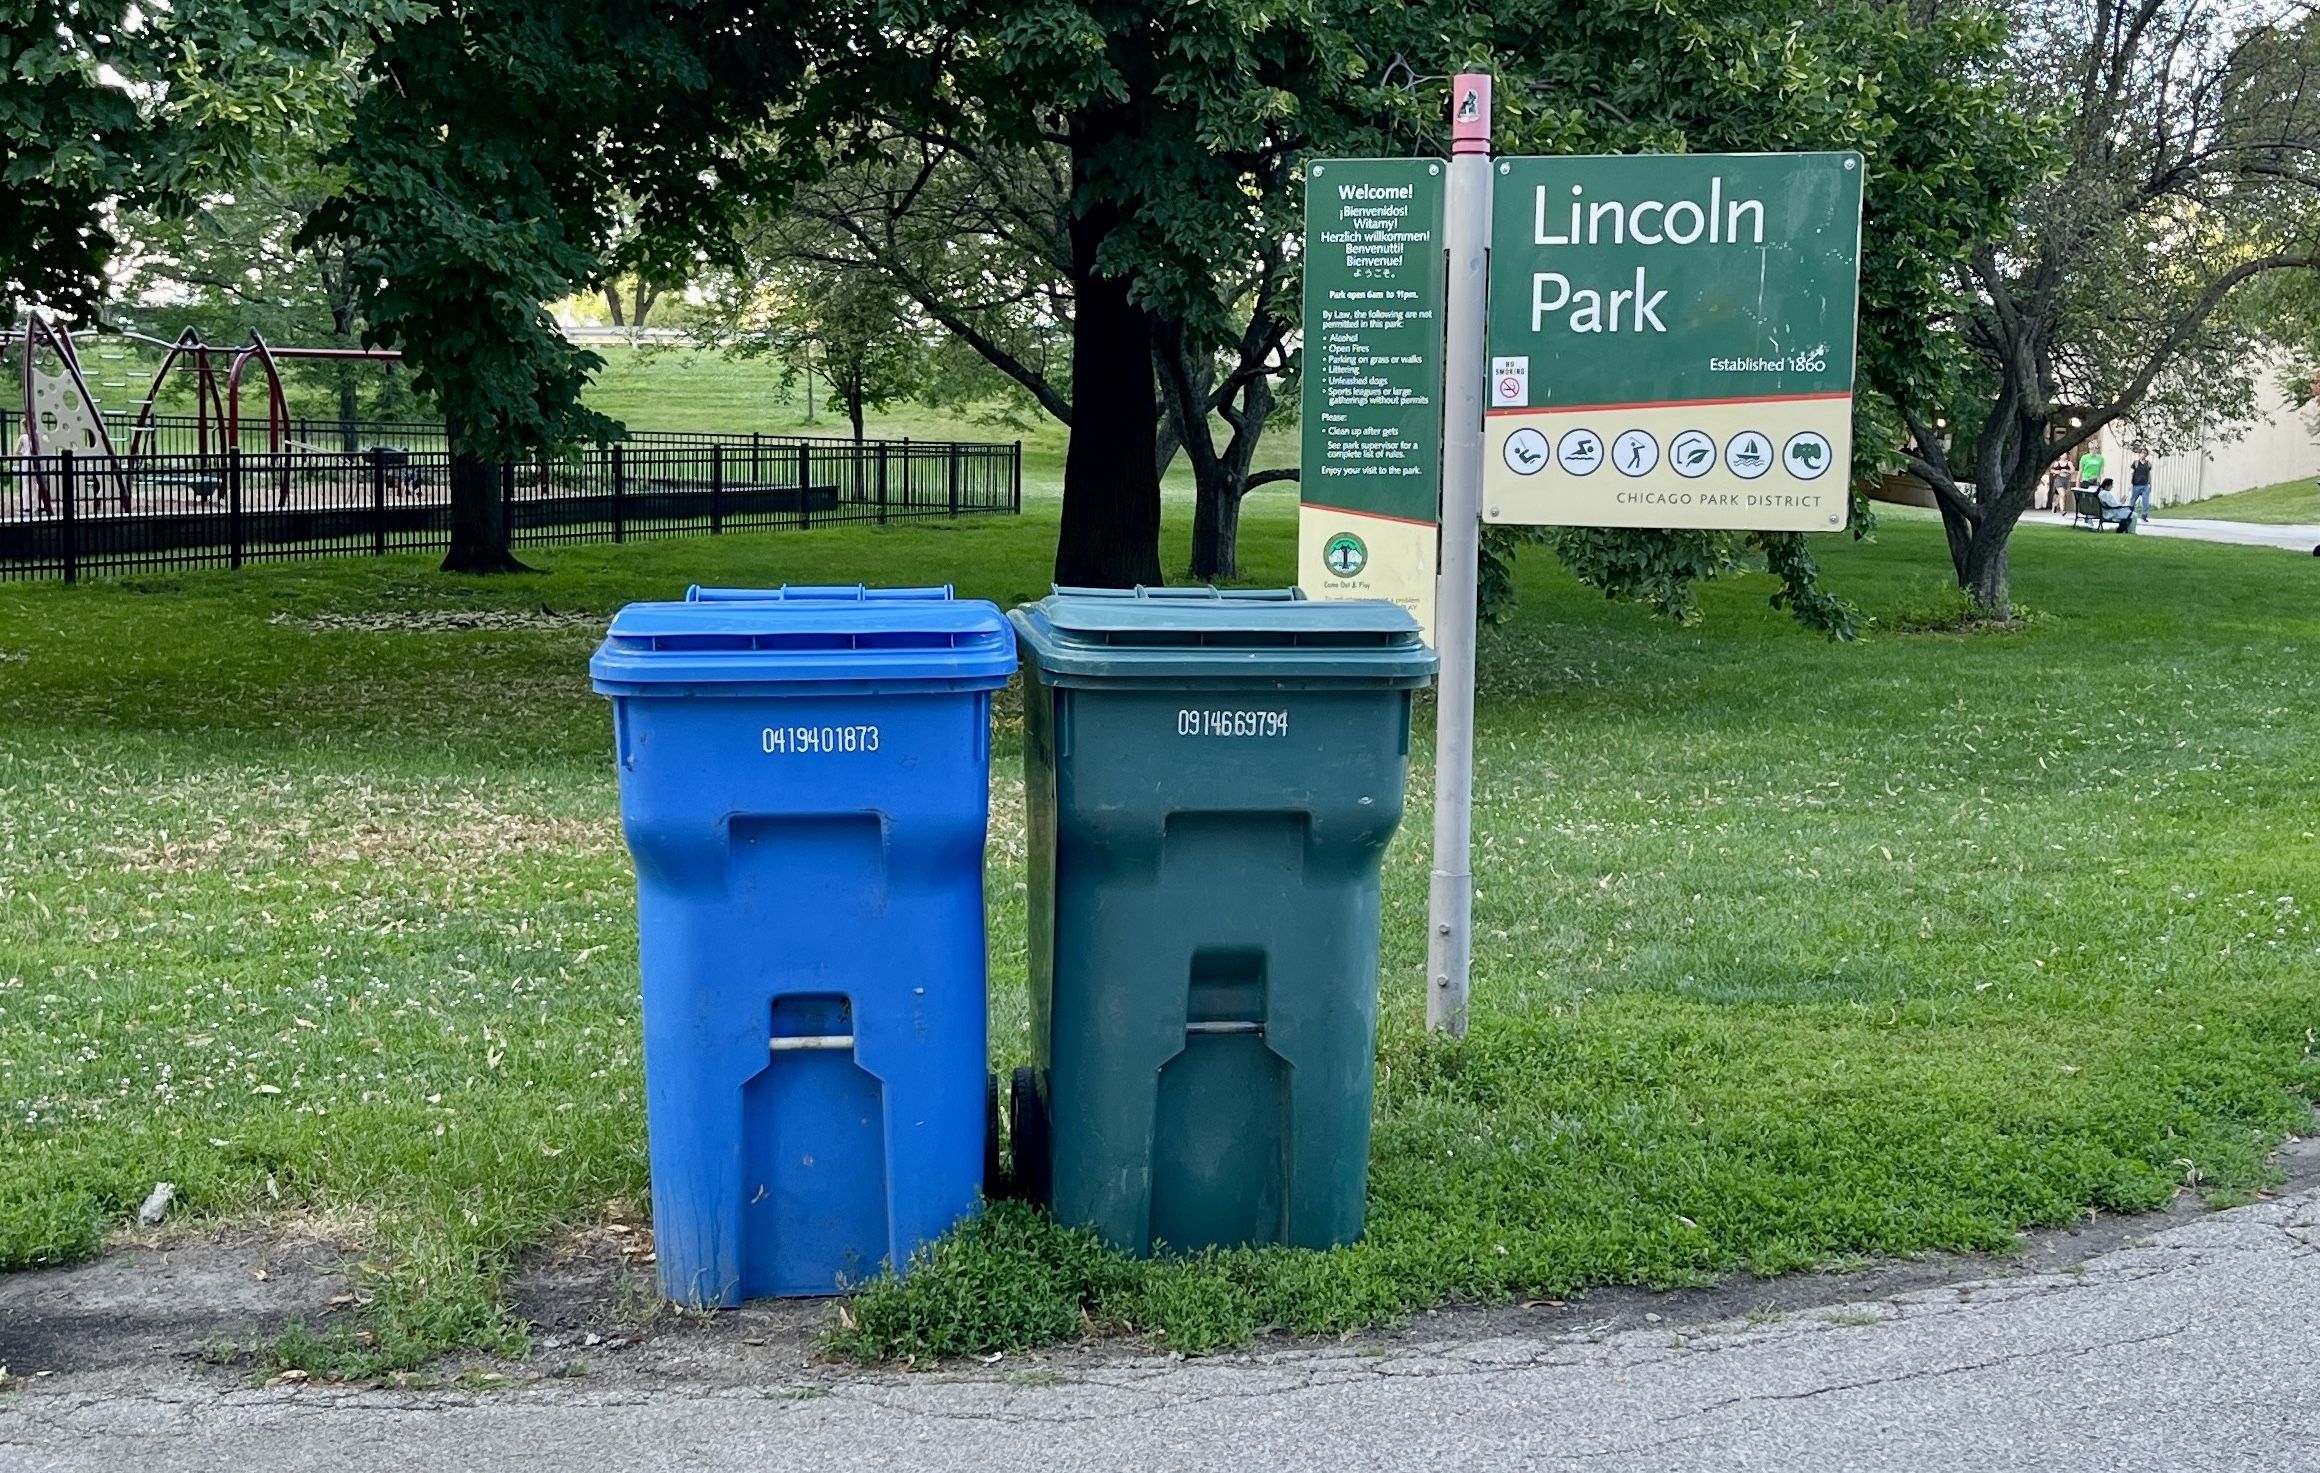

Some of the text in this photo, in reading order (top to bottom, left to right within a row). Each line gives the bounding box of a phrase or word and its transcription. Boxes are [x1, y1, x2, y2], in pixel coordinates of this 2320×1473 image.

[1338, 184, 1412, 200] Welcome!
[1534, 177, 1765, 245] Lincoln
[1353, 218, 1397, 231] Witamy!
[1321, 231, 1430, 242] Herzlich willkommen!
[1347, 255, 1402, 266] Bienvenue!
[1330, 290, 1346, 299] Park
[1347, 292, 1365, 300] open
[1367, 290, 1383, 298] 6am
[1531, 266, 1668, 333] Park
[1368, 310, 1403, 320] following
[1405, 311, 1418, 319] are
[1419, 310, 1432, 318] not
[1323, 320, 1359, 330] permitted
[1361, 320, 1368, 328] in
[1370, 320, 1383, 328] this
[1330, 333, 1358, 342] Alcohol
[1329, 344, 1369, 354] Open Fires
[1328, 355, 1422, 366] Parking on grass or walks
[1710, 357, 1826, 372] Established 1860
[1329, 365, 1360, 375] Littering
[1329, 376, 1388, 387] Unleashed dogs
[1328, 387, 1412, 398] Sports leagues or large
[1329, 397, 1368, 406] gatherings
[1400, 397, 1428, 406] permits
[1328, 426, 1350, 435] Clean
[1351, 429, 1361, 437] up
[1363, 427, 1381, 435] after
[1328, 441, 1419, 450] See park supervisor for a
[1327, 450, 1405, 460] complete list of rules.
[1322, 466, 1342, 476] Enjoy
[1343, 468, 1361, 476] your
[1362, 466, 1377, 474] visit
[1389, 466, 1401, 474] the
[1403, 466, 1422, 476] park.
[1616, 491, 1823, 507] CHICAGO PARK DISTRICT
[1323, 580, 1339, 589] Come
[1178, 709, 1289, 737] 0914669794
[762, 725, 879, 753] 0419401873
